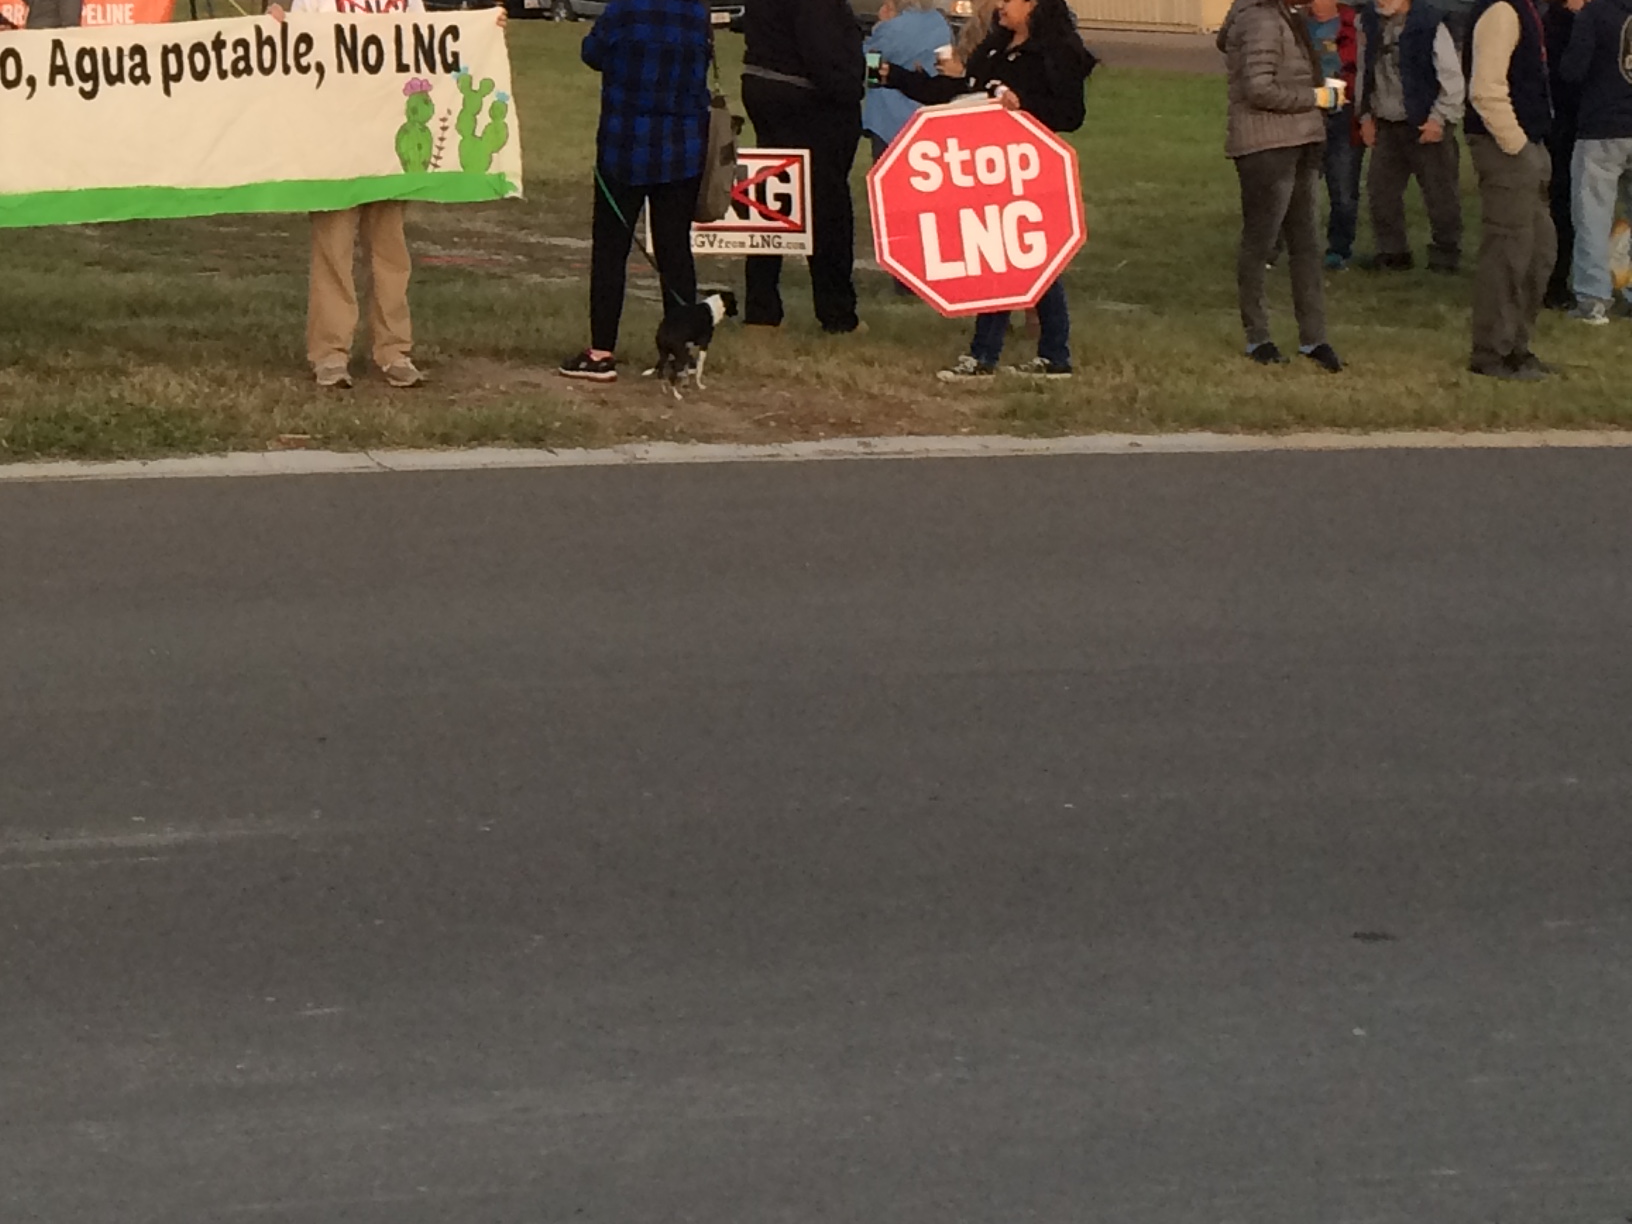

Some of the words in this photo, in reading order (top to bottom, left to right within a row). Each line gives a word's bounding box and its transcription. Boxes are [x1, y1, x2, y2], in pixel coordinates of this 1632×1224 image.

[48, 38, 151, 100] Agua
[161, 21, 325, 97] potable,
[334, 23, 385, 75] No
[394, 23, 461, 74] LNG
[907, 137, 1040, 197] Stop
[919, 200, 1047, 282] LNG
